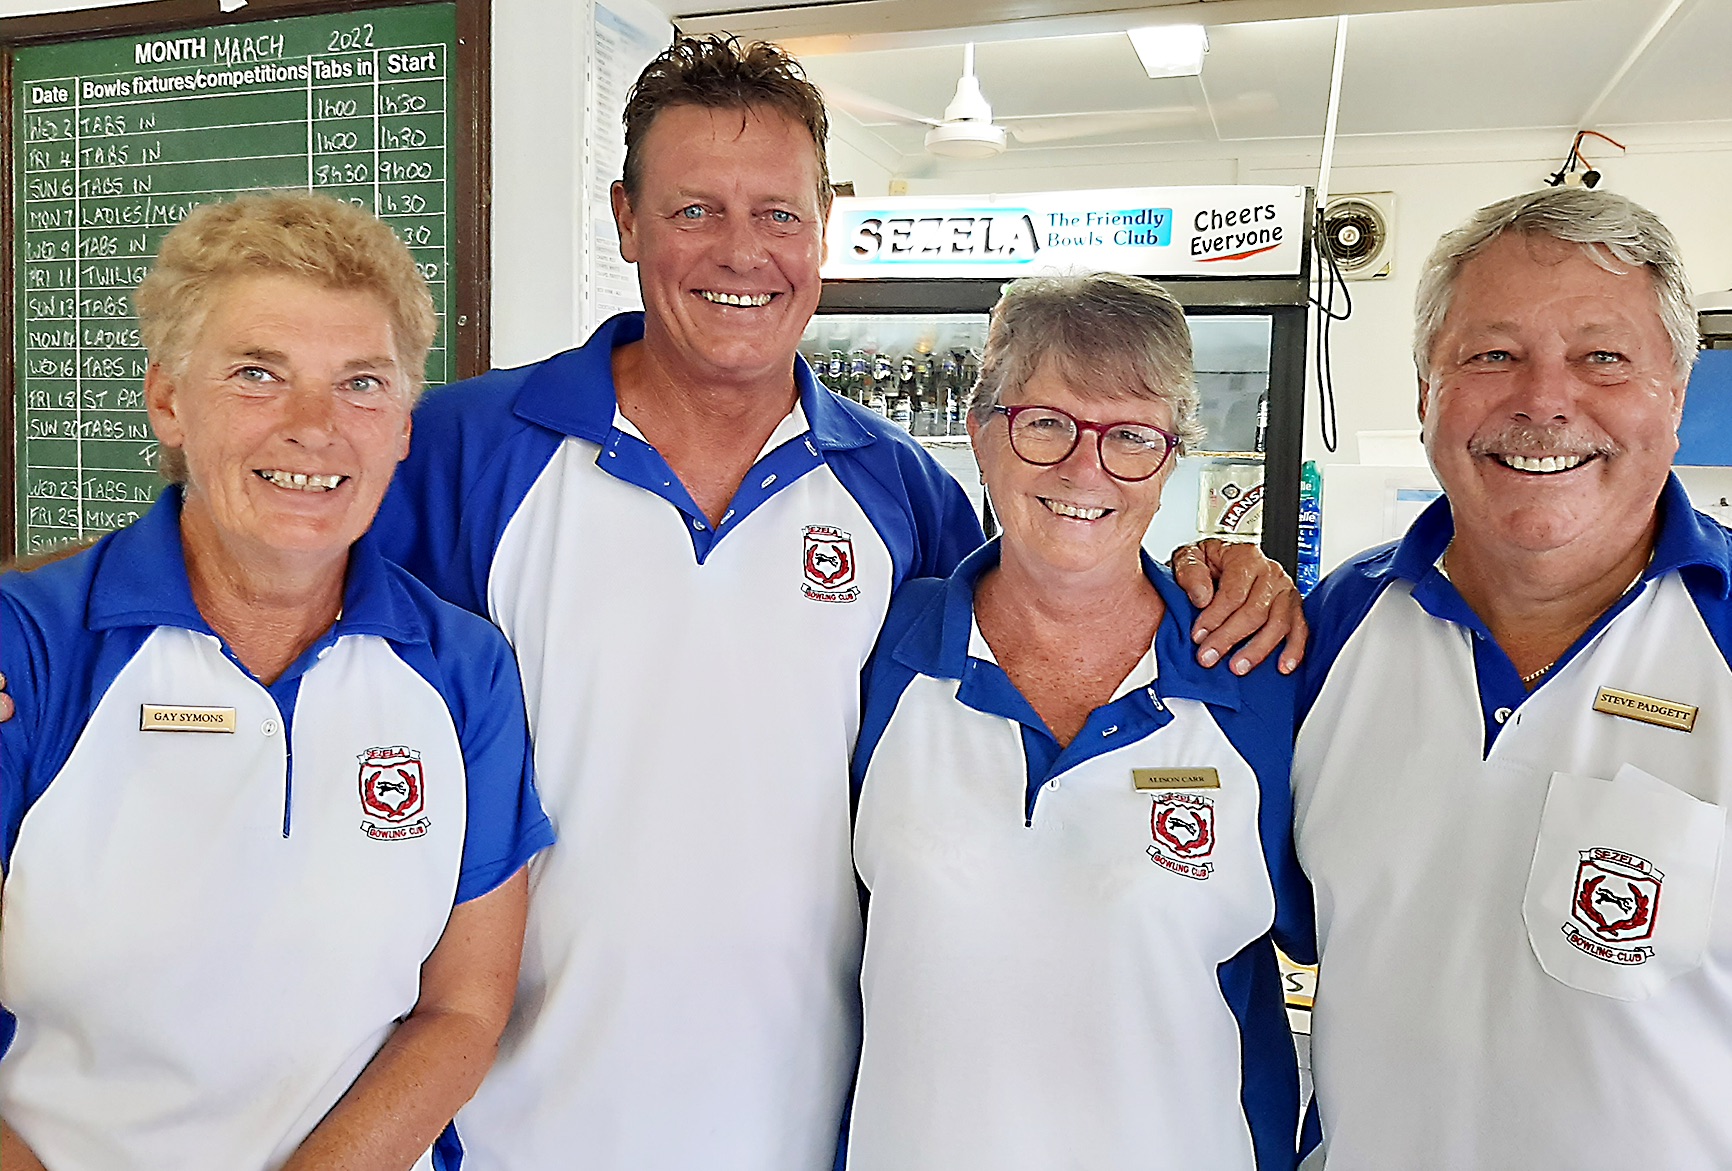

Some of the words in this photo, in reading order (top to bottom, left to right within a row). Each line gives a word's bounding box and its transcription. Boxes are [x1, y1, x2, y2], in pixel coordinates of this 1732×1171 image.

[135, 37, 206, 64] MONTH
[213, 33, 285, 67] MARCH
[327, 24, 374, 52] 2022
[312, 60, 352, 80] Tabs
[357, 58, 373, 77] in
[387, 51, 436, 74] Start
[82, 80, 131, 100] Bowls
[132, 63, 308, 94] fixtures/competitions
[32, 86, 69, 104] Date
[63, 118, 73, 139] 2
[79, 115, 126, 136] TABS
[139, 112, 156, 131] IN
[60, 151, 72, 168] 4
[80, 144, 129, 166] TABS
[142, 140, 161, 164] IN
[29, 178, 58, 199] SUN
[62, 178, 73, 197] 6
[79, 177, 124, 198] TABS
[133, 174, 152, 194] IN
[30, 208, 60, 229] MON
[64, 209, 73, 227] 7
[1047, 212, 1081, 228] The
[1086, 208, 1165, 230] Friendly
[1192, 202, 1277, 233] Cheers
[78, 235, 118, 257] TABS
[129, 233, 146, 252] IN
[850, 213, 1041, 261] SEZELA
[1047, 230, 1103, 248] Bowls
[1113, 228, 1159, 247] Club
[1190, 224, 1285, 257] Everyone
[61, 240, 70, 258] 9
[29, 296, 56, 317] SUN
[29, 329, 61, 348] MON
[84, 328, 141, 349] LADIES
[29, 358, 58, 376] WED
[60, 359, 74, 377] 16
[82, 356, 125, 378] TABS
[132, 357, 149, 377] IN
[29, 389, 51, 409] FRI
[58, 391, 76, 408] 18
[83, 389, 108, 409] ST
[30, 418, 58, 437] SUN
[80, 419, 125, 439] TABS
[128, 423, 148, 440] IN
[60, 480, 79, 500] 23
[82, 477, 128, 501] TABS
[134, 485, 152, 501] IN
[29, 506, 51, 526] FRI
[58, 507, 78, 527] 25
[1600, 693, 1636, 708] STEVE
[1636, 701, 1691, 720] PADGETT
[154, 712, 178, 722] GAY
[180, 712, 224, 723] SYMONS
[1154, 854, 1190, 874] BOWLING
[1594, 848, 1645, 871] SEZELA
[1570, 934, 1614, 959] BOWLING
[1616, 952, 1643, 963] CLUB
